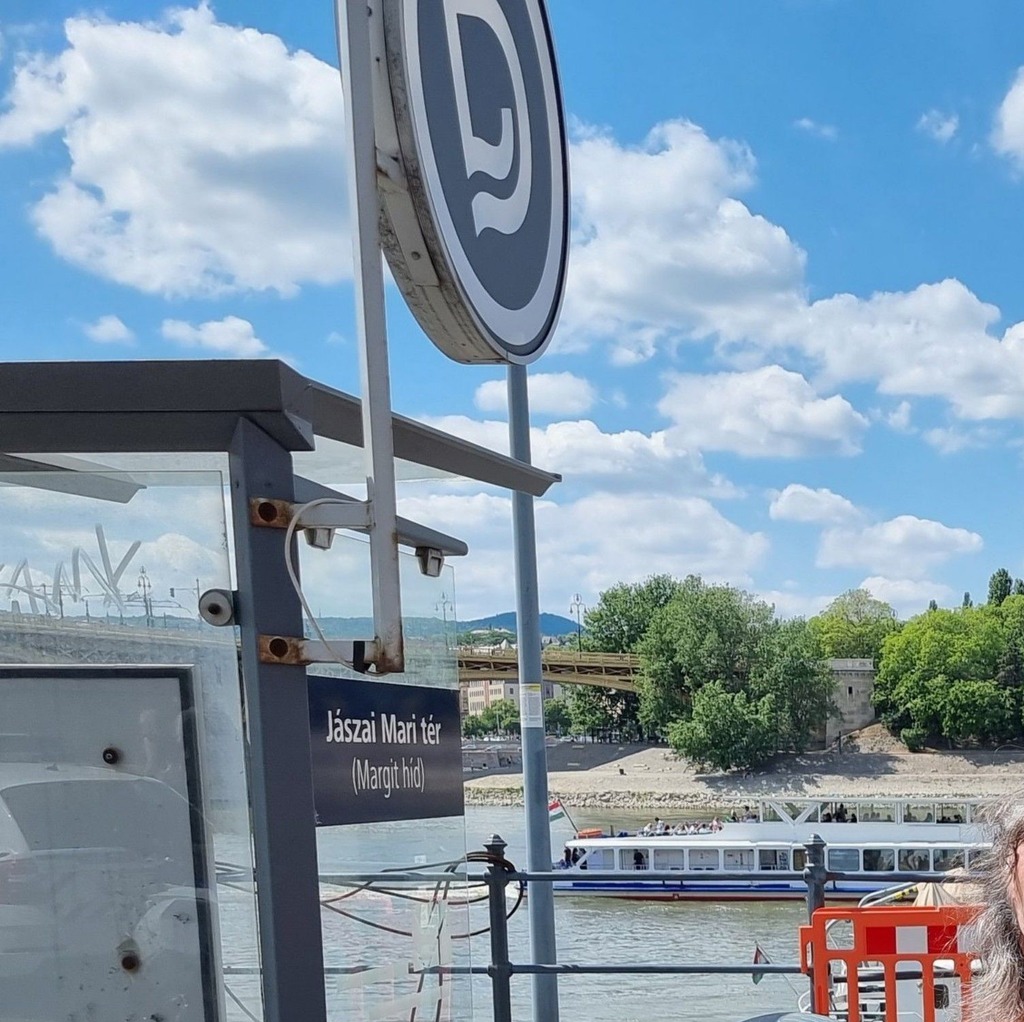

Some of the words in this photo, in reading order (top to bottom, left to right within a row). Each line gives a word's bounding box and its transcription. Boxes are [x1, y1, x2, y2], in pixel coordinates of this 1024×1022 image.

[326, 708, 377, 743] Jászai
[380, 713, 417, 744] Mari
[420, 714, 442, 745] tér
[352, 757, 400, 798] (Margit
[402, 757, 425, 793] híd)
